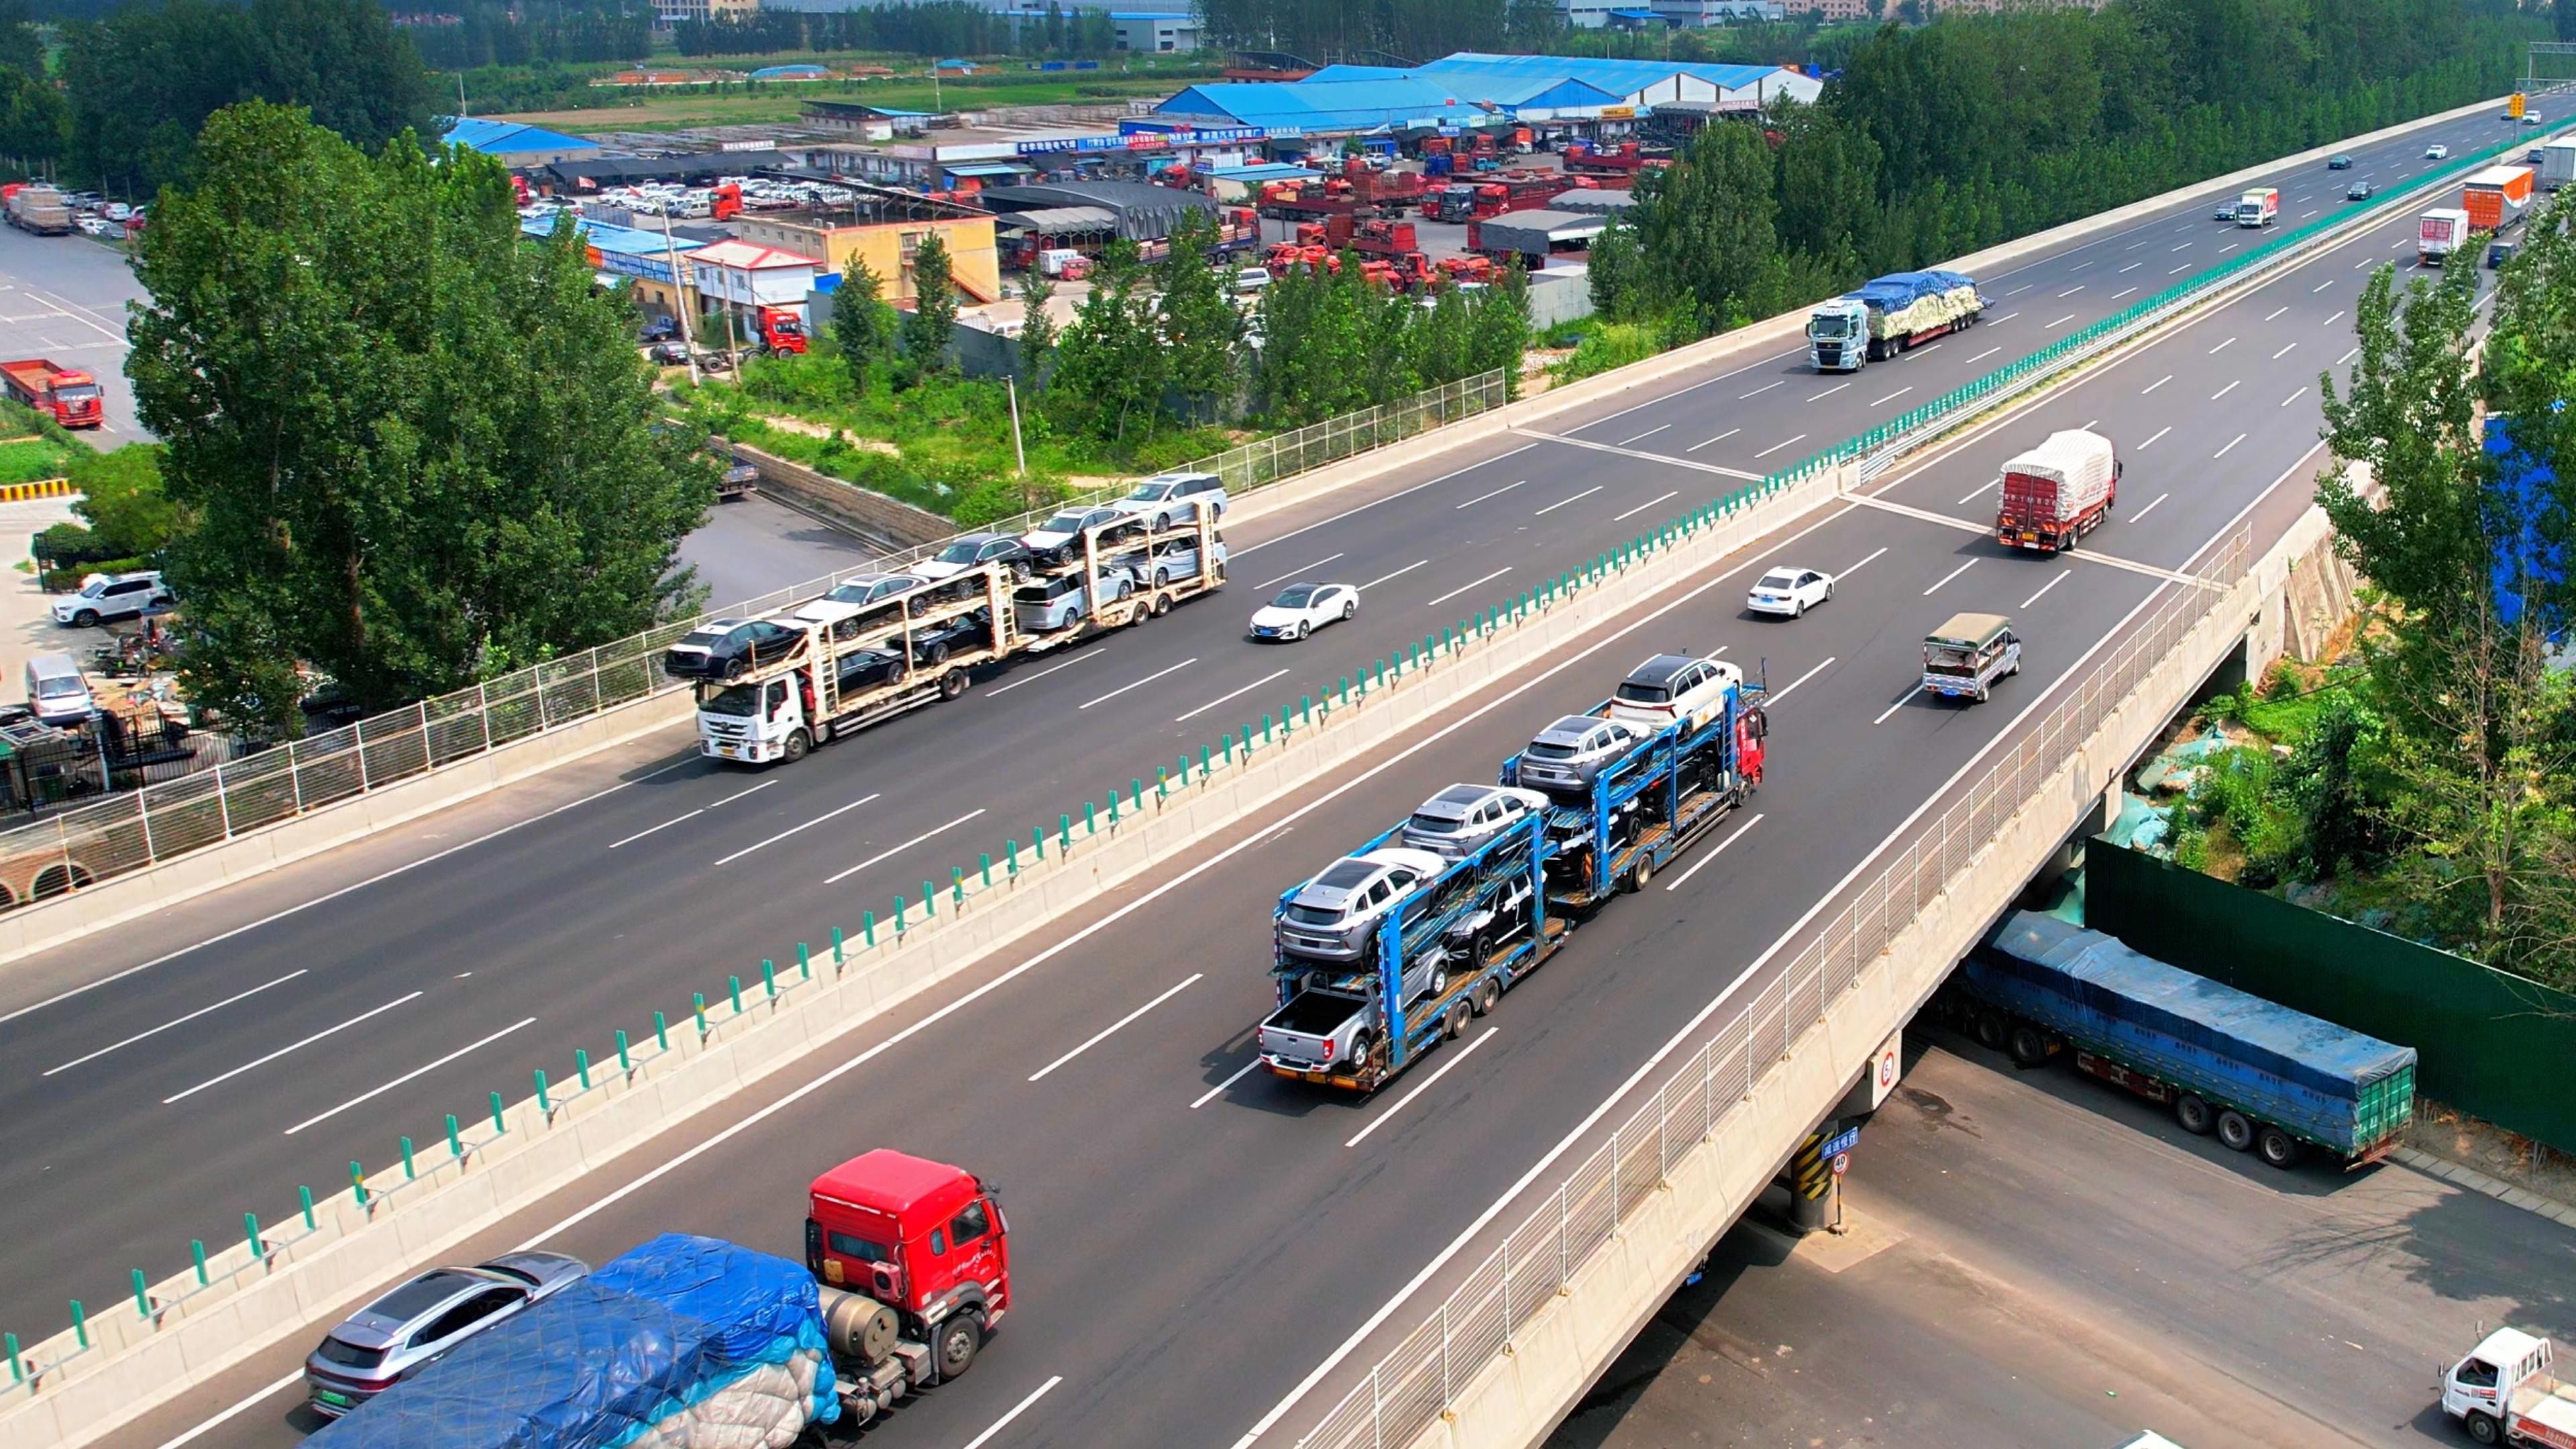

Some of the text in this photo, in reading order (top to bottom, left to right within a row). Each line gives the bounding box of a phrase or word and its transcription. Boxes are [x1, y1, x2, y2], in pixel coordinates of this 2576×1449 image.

[1824, 1130, 1856, 1157] 减速慢行
[1835, 1156, 1845, 1166] 40
